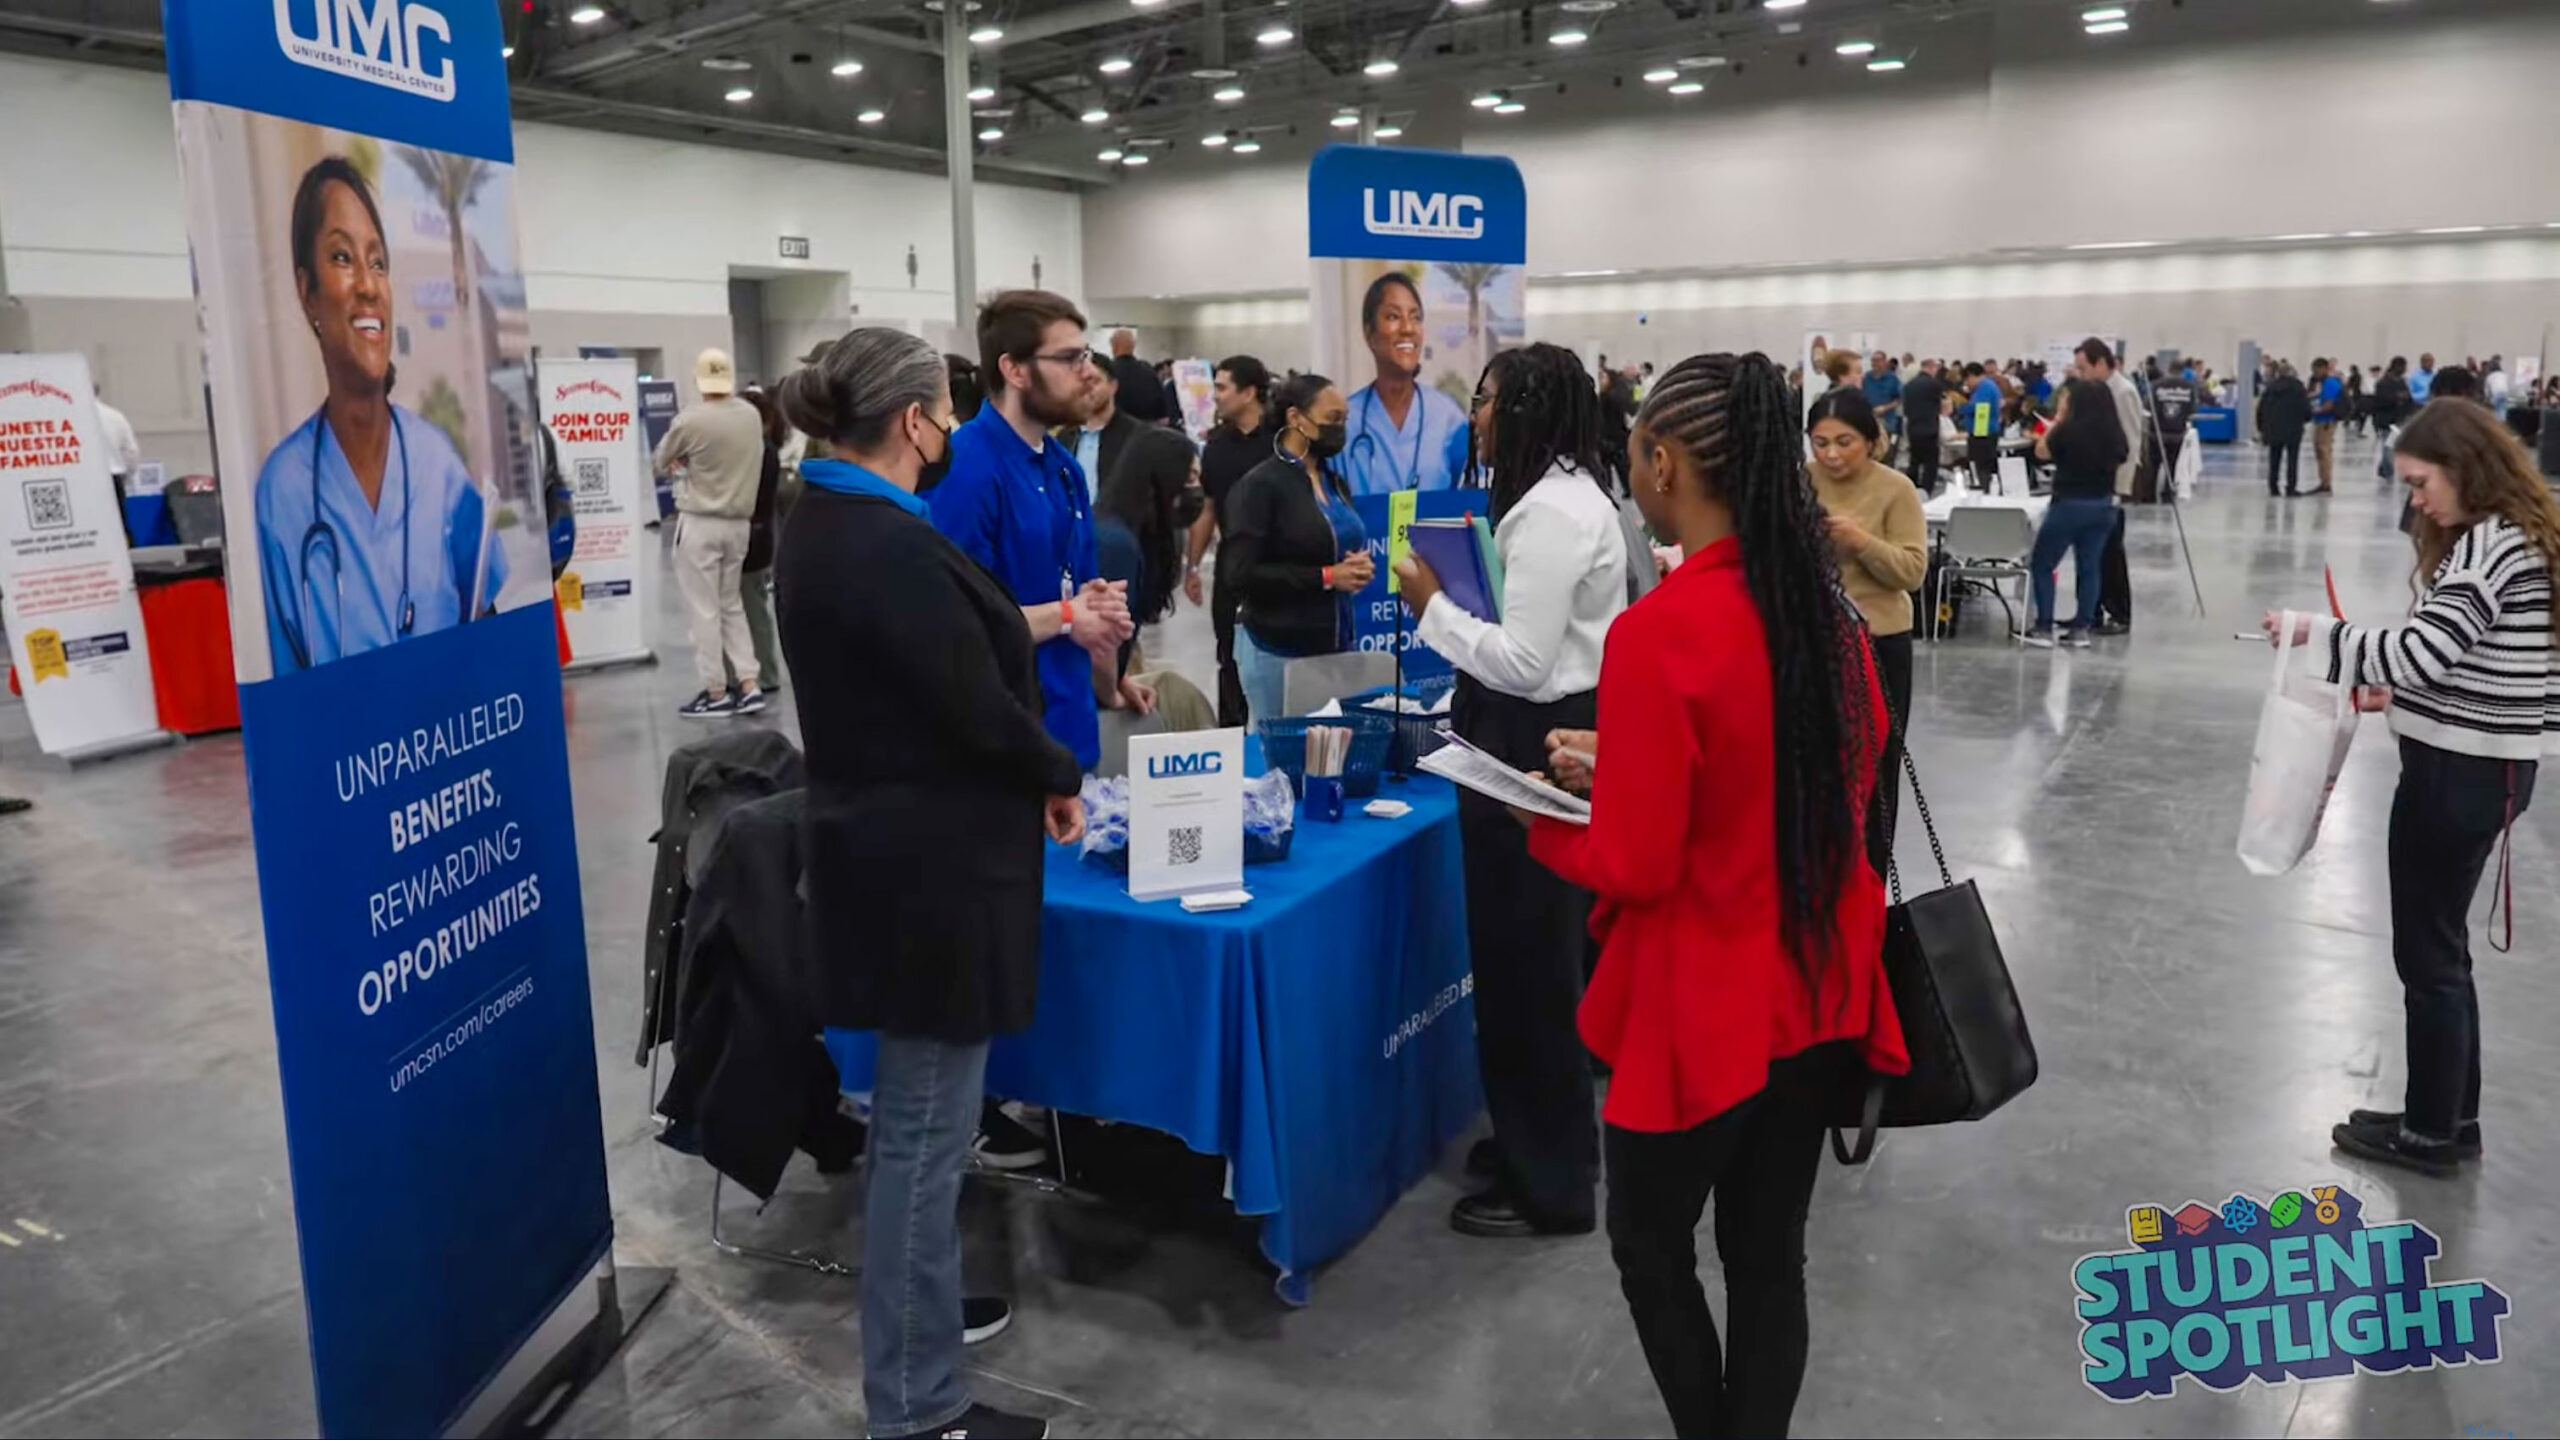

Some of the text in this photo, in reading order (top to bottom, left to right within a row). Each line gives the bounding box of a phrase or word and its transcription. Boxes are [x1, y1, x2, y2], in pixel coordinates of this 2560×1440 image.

[273, 0, 456, 102] UMC
[292, 43, 446, 94] UNIVERSITY MEDICAL CENTER
[1363, 187, 1484, 239] UMC
[782, 240, 807, 257] EXIT
[62, 419, 73, 432] A
[551, 413, 589, 427] JOIN
[593, 412, 630, 426] OUR
[557, 428, 624, 442] FAMILY!
[0, 451, 80, 469] FAMILIA!
[336, 693, 524, 802] UNPARALLELED
[1148, 751, 1222, 779] UMC
[390, 768, 501, 853] BENEFITS,
[369, 821, 521, 938] REWARDING
[358, 873, 541, 1016] OPPORTUNITIES
[390, 974, 534, 1093] umcsn.com/careers
